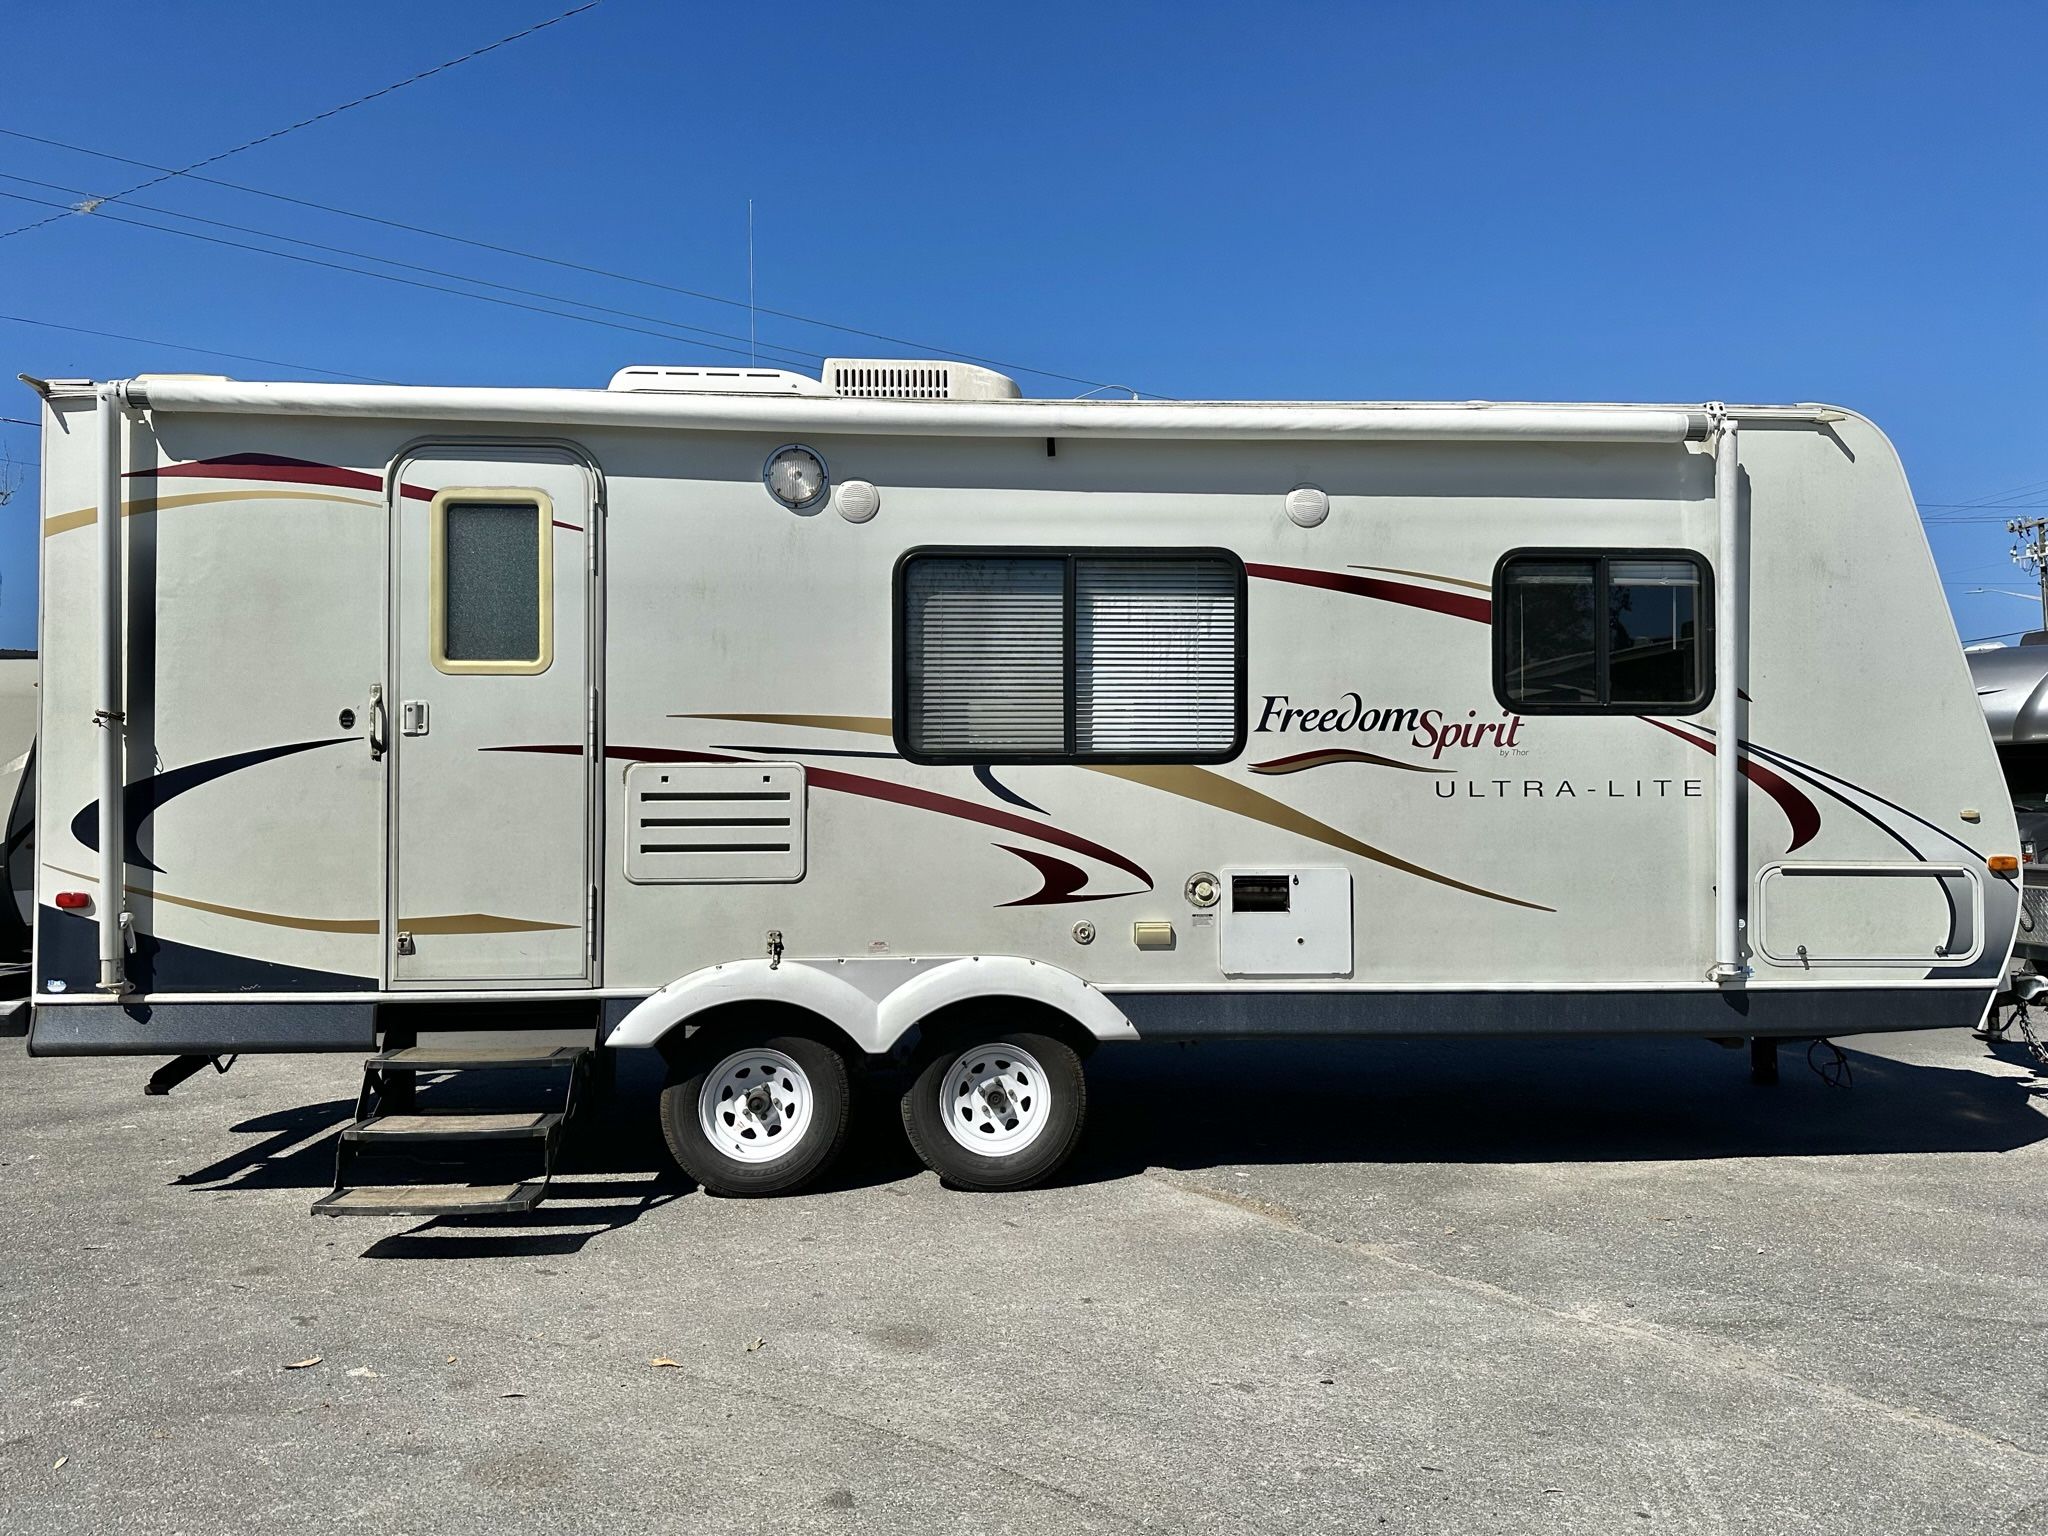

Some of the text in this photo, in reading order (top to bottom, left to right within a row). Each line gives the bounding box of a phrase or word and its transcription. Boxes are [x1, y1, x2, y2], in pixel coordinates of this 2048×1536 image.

[1499, 749, 1530, 758] by Thor
[1434, 779, 1703, 799] ULTRA-LITE
